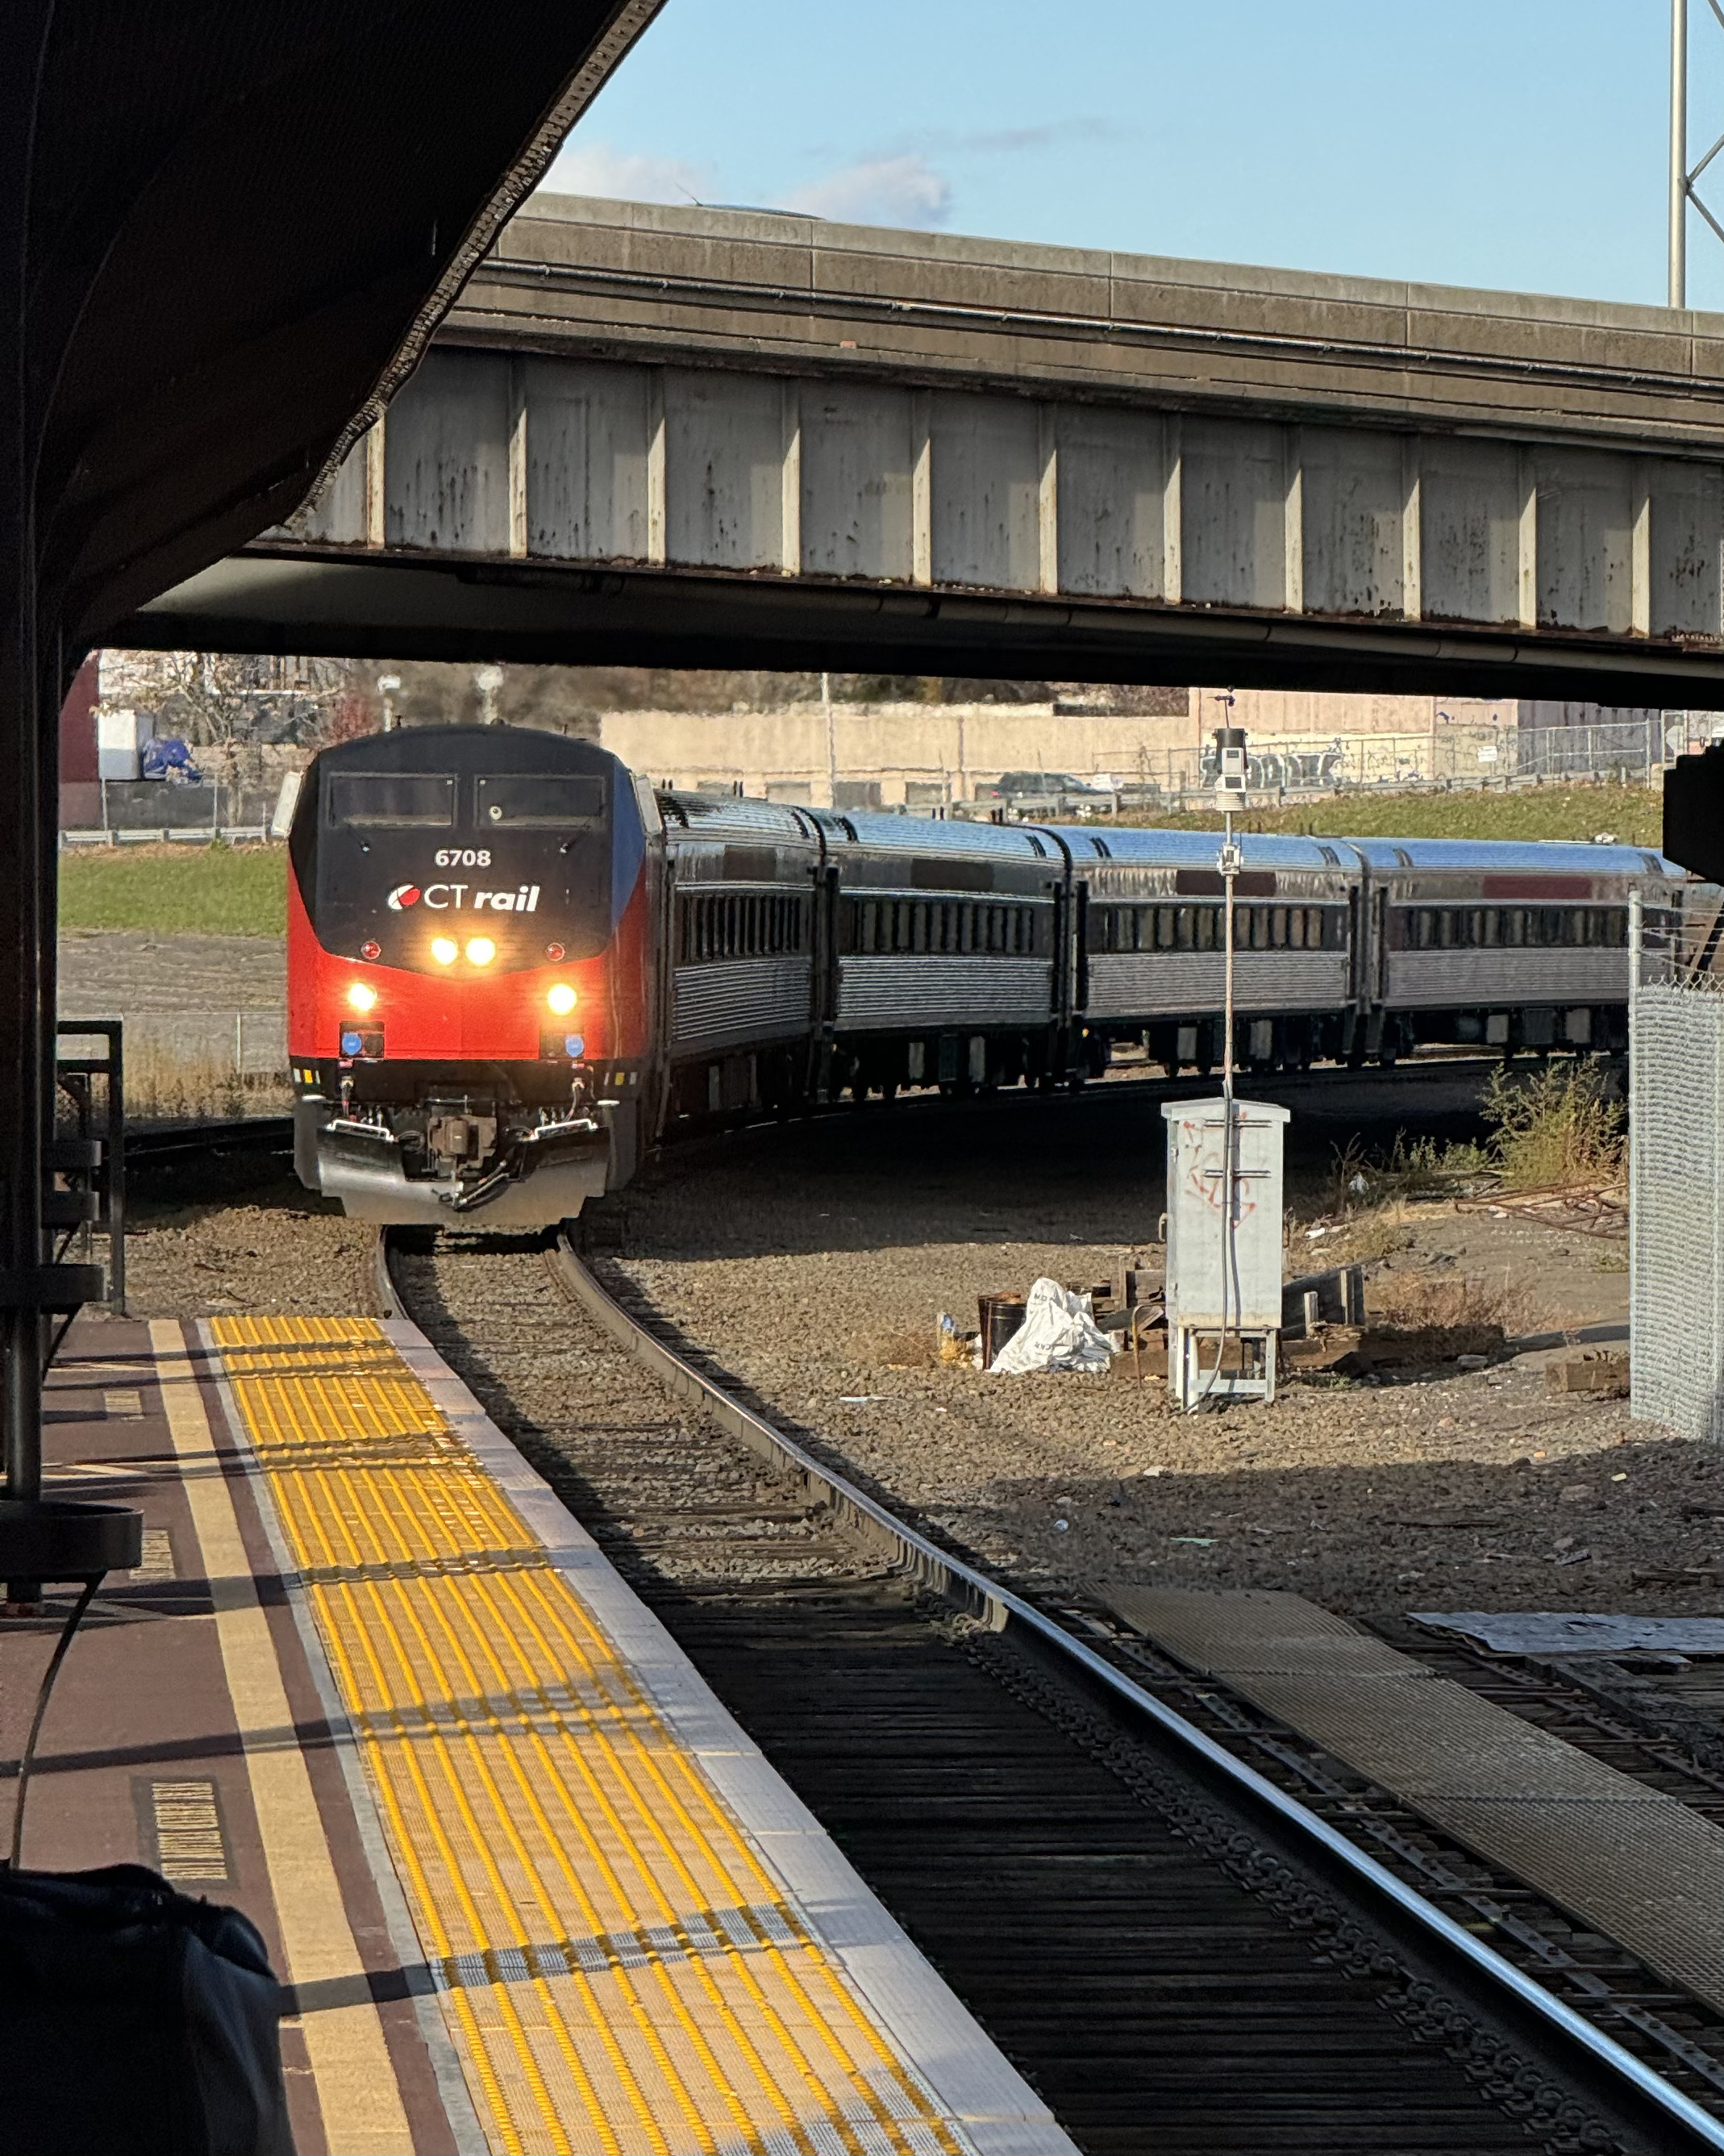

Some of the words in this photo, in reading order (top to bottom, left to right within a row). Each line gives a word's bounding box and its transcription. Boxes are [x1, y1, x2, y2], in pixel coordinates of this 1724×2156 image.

[435, 849, 491, 867] 6708
[424, 884, 468, 909] CT
[473, 885, 540, 911] rail
